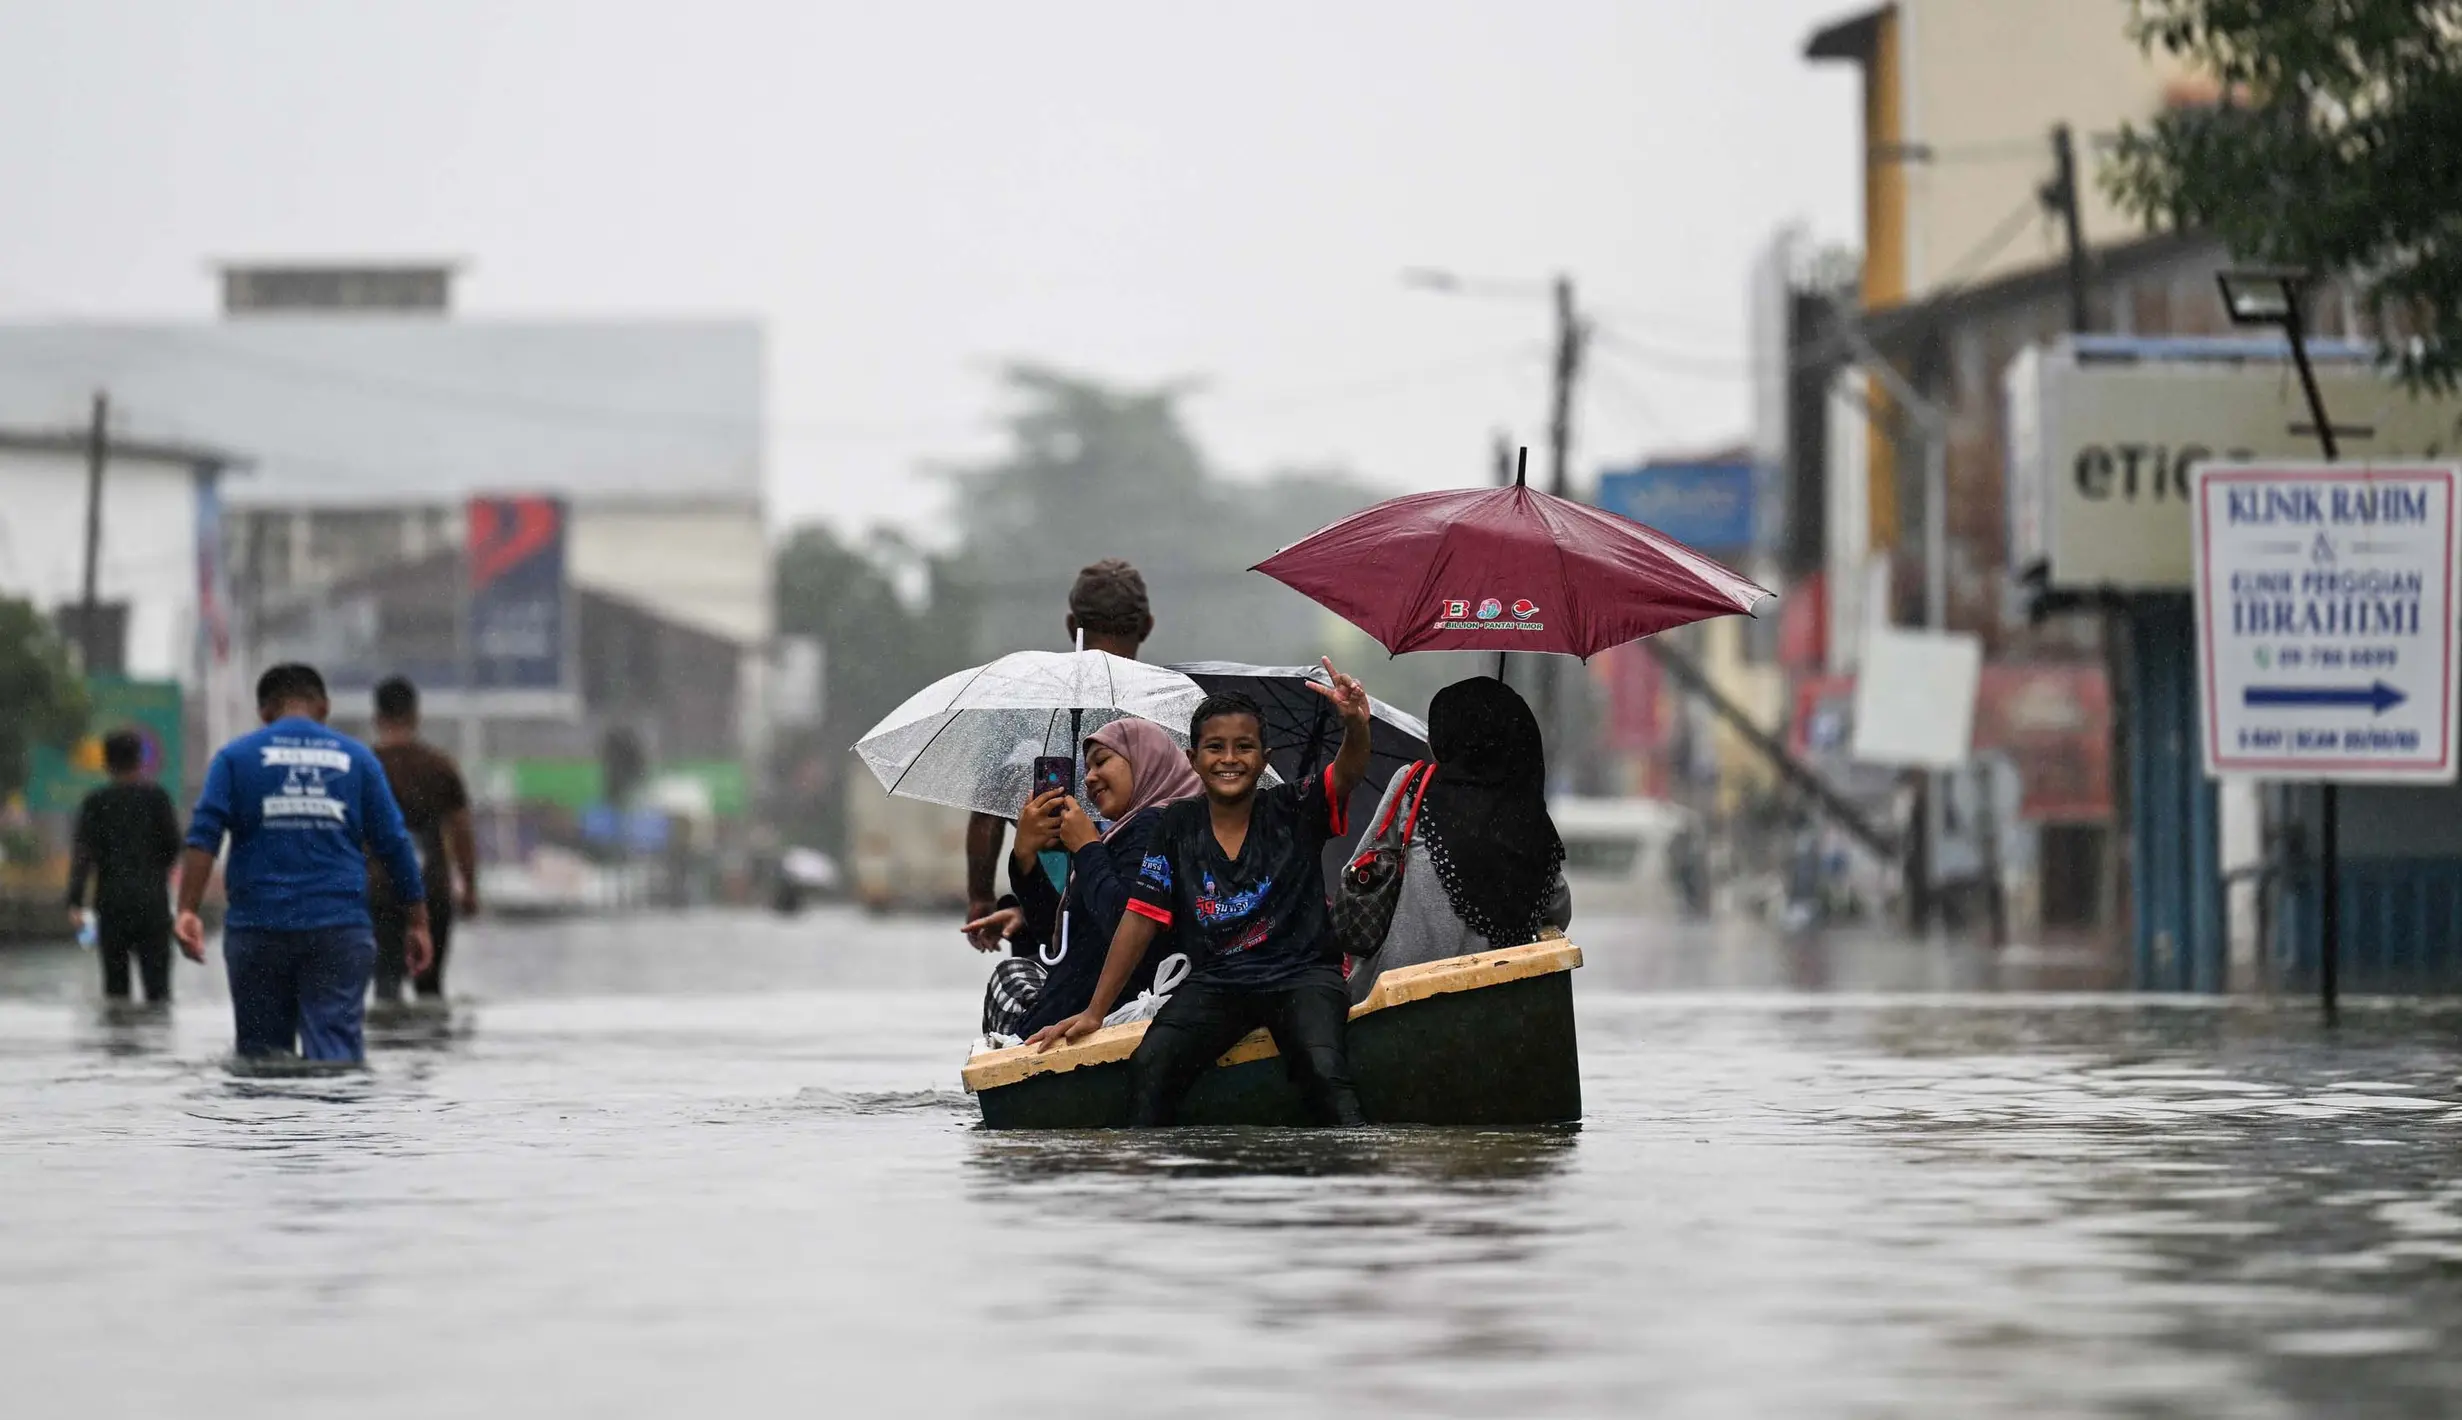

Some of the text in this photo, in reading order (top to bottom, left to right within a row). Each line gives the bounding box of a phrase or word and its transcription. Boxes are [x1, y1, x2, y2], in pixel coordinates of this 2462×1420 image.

[2227, 485, 2427, 524] KLINIK RAHIM
[1484, 621, 1514, 630] PANTAI
[1516, 622, 1544, 631] TIMOR
[2233, 600, 2420, 636] IBRAHIMI
